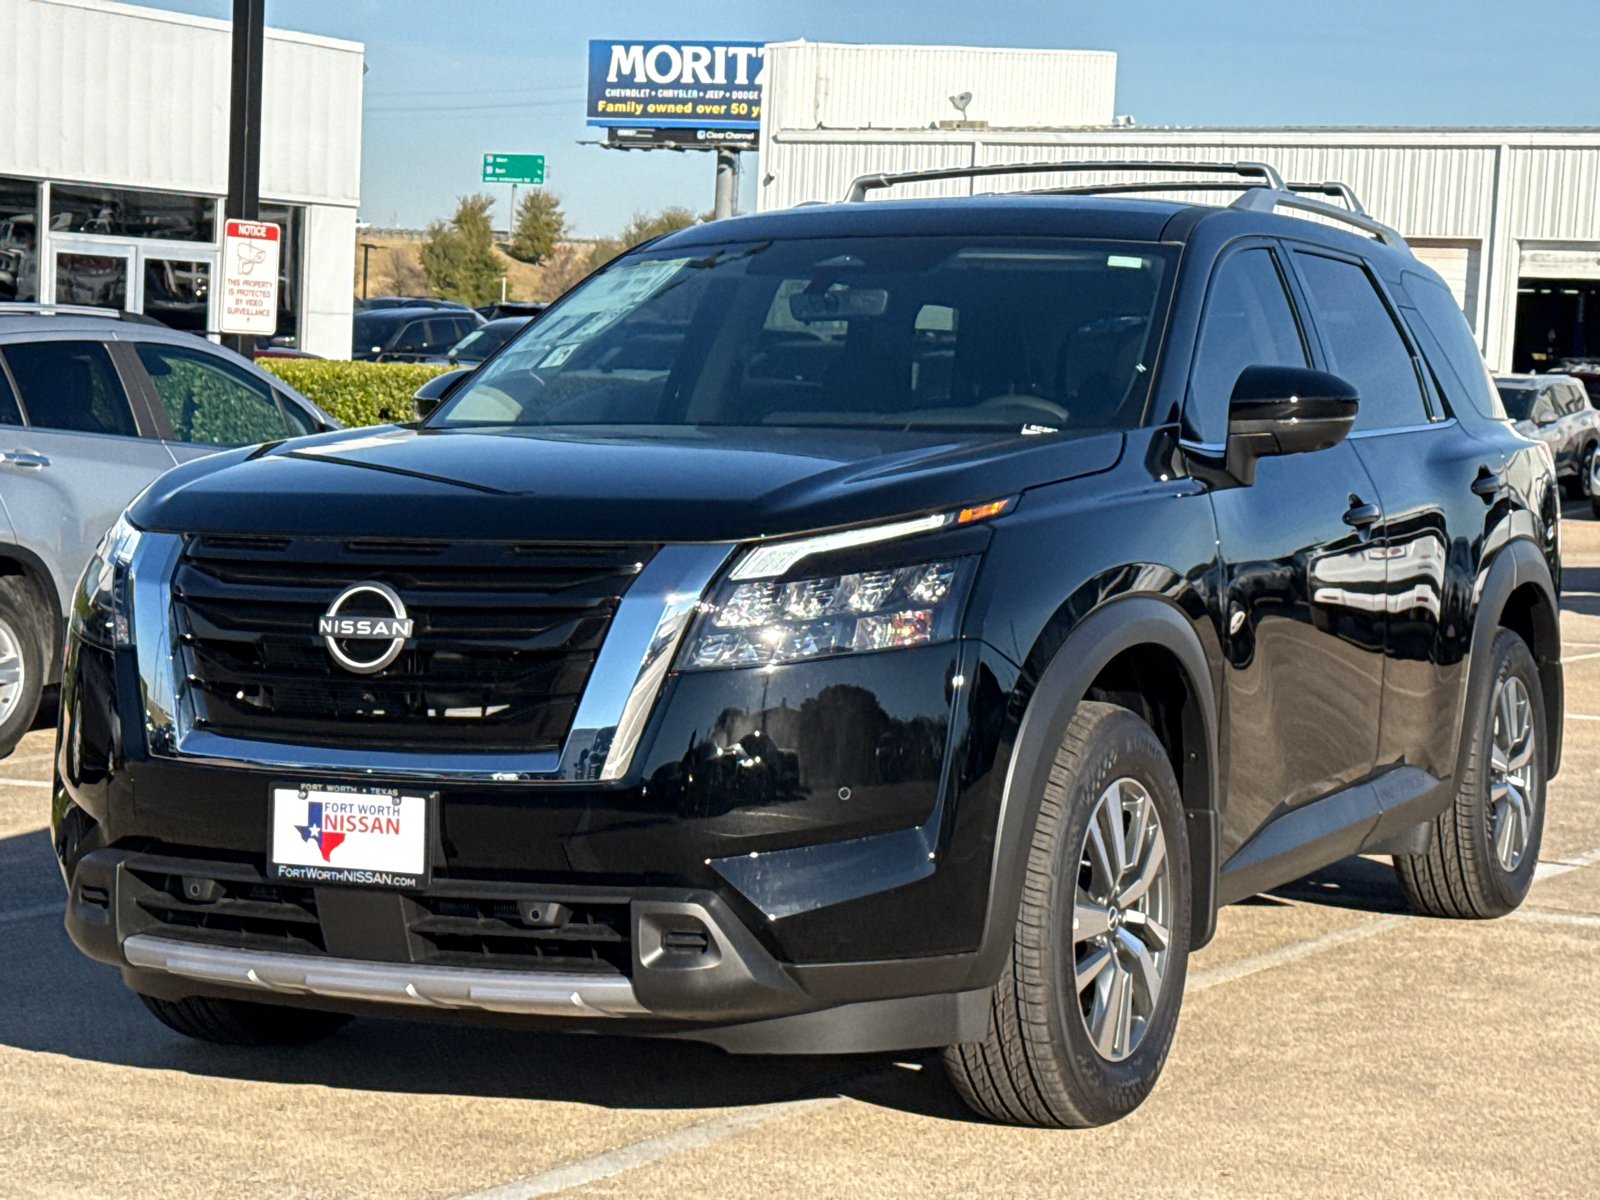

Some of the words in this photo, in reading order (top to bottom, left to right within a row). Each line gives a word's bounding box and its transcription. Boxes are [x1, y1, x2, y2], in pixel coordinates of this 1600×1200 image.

[605, 88, 650, 98] CHEVROLET
[657, 89, 698, 99] CHRYSLER
[705, 90, 724, 99] JEEP
[732, 90, 759, 99] DODGE
[597, 101, 643, 115] Family
[647, 102, 692, 113] owned
[696, 104, 726, 114] over
[730, 103, 748, 114] 50
[238, 225, 267, 237] NOTICE
[227, 278, 240, 287] THIS
[242, 280, 272, 289] PROPERTY
[237, 289, 271, 298] PROTECTED
[245, 299, 263, 307] VIDEO
[227, 307, 271, 317] SURVEILLANCE
[320, 619, 409, 636] NISSAN
[300, 783, 323, 791] FORT
[326, 785, 357, 793] WORTH
[370, 787, 399, 796] TEXAS
[324, 802, 354, 814] FORT
[358, 804, 400, 816] WORTH
[324, 814, 400, 835] NISSAN
